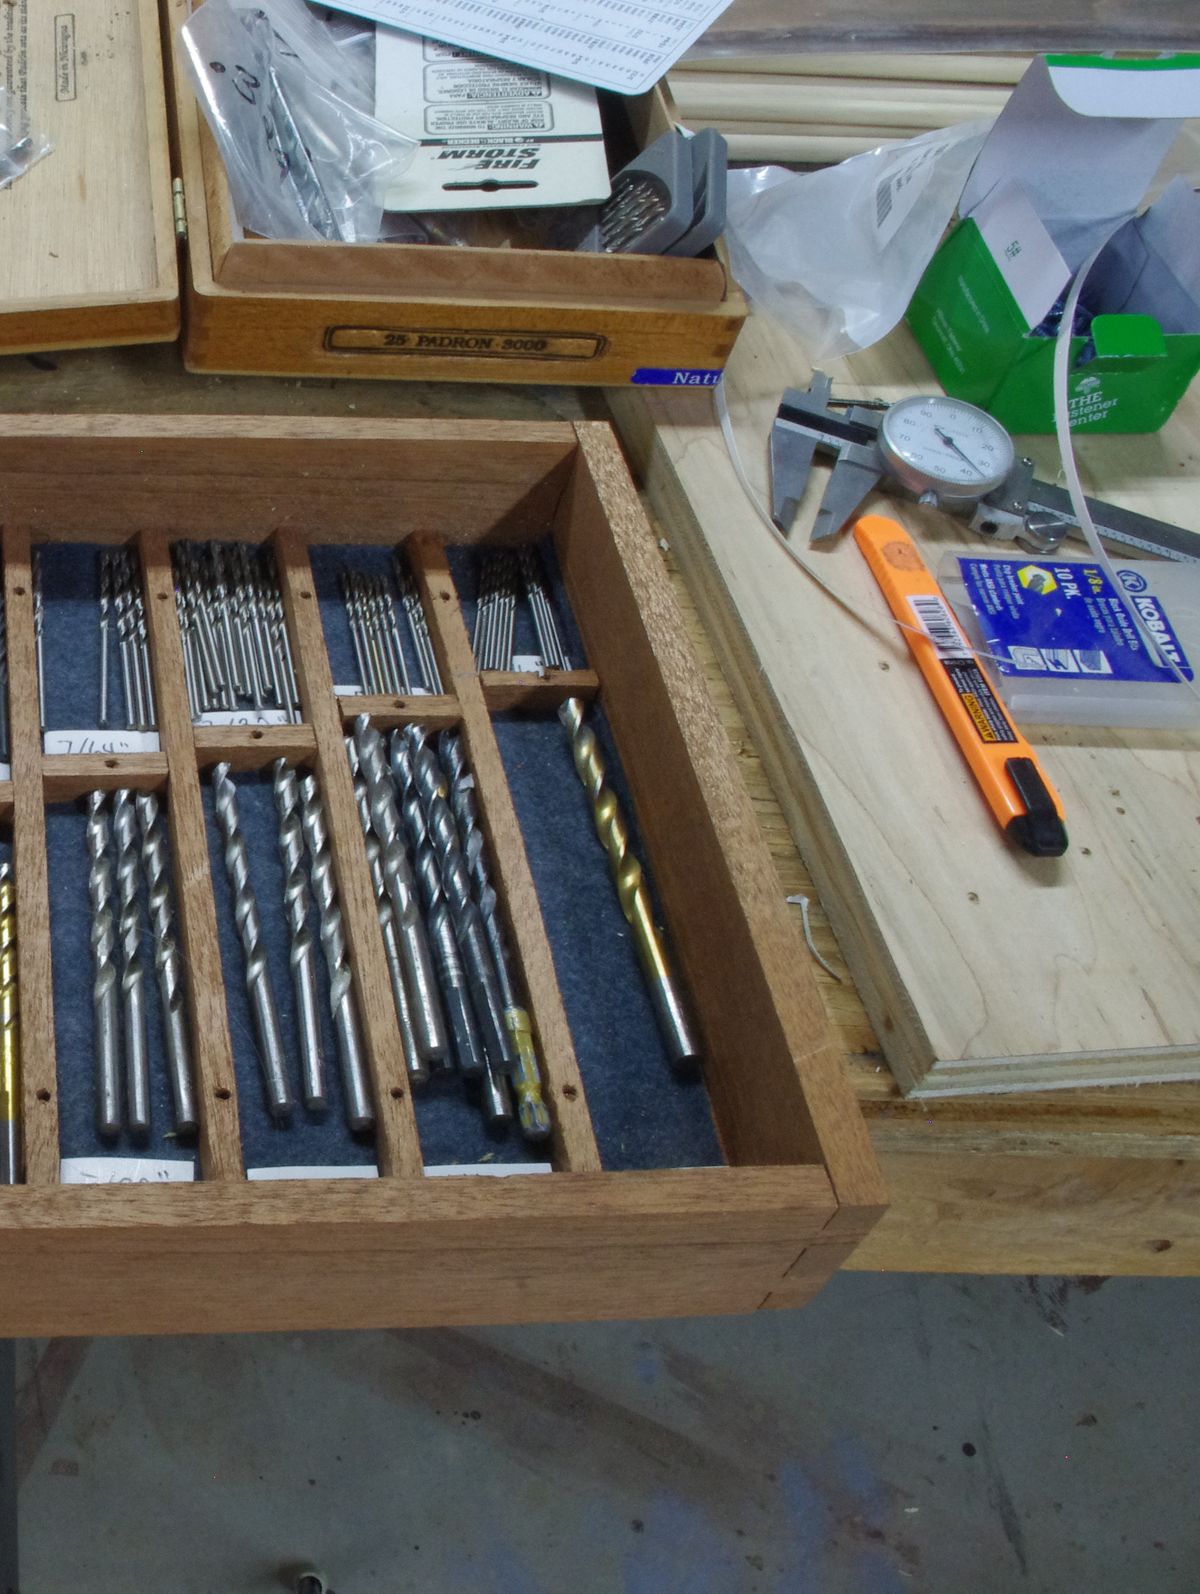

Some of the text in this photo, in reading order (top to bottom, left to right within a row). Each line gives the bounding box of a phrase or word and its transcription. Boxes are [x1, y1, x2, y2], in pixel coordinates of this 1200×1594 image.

[436, 147, 539, 159] STORM
[474, 158, 540, 169] FIRE
[417, 335, 492, 350] PADRON
[1069, 391, 1103, 408] THE
[1068, 411, 1108, 428] enter
[1054, 567, 1082, 599] 10 PK.
[1080, 568, 1104, 584] 1/8
[1134, 598, 1181, 663] KOBALT
[965, 694, 991, 733] WARNING
